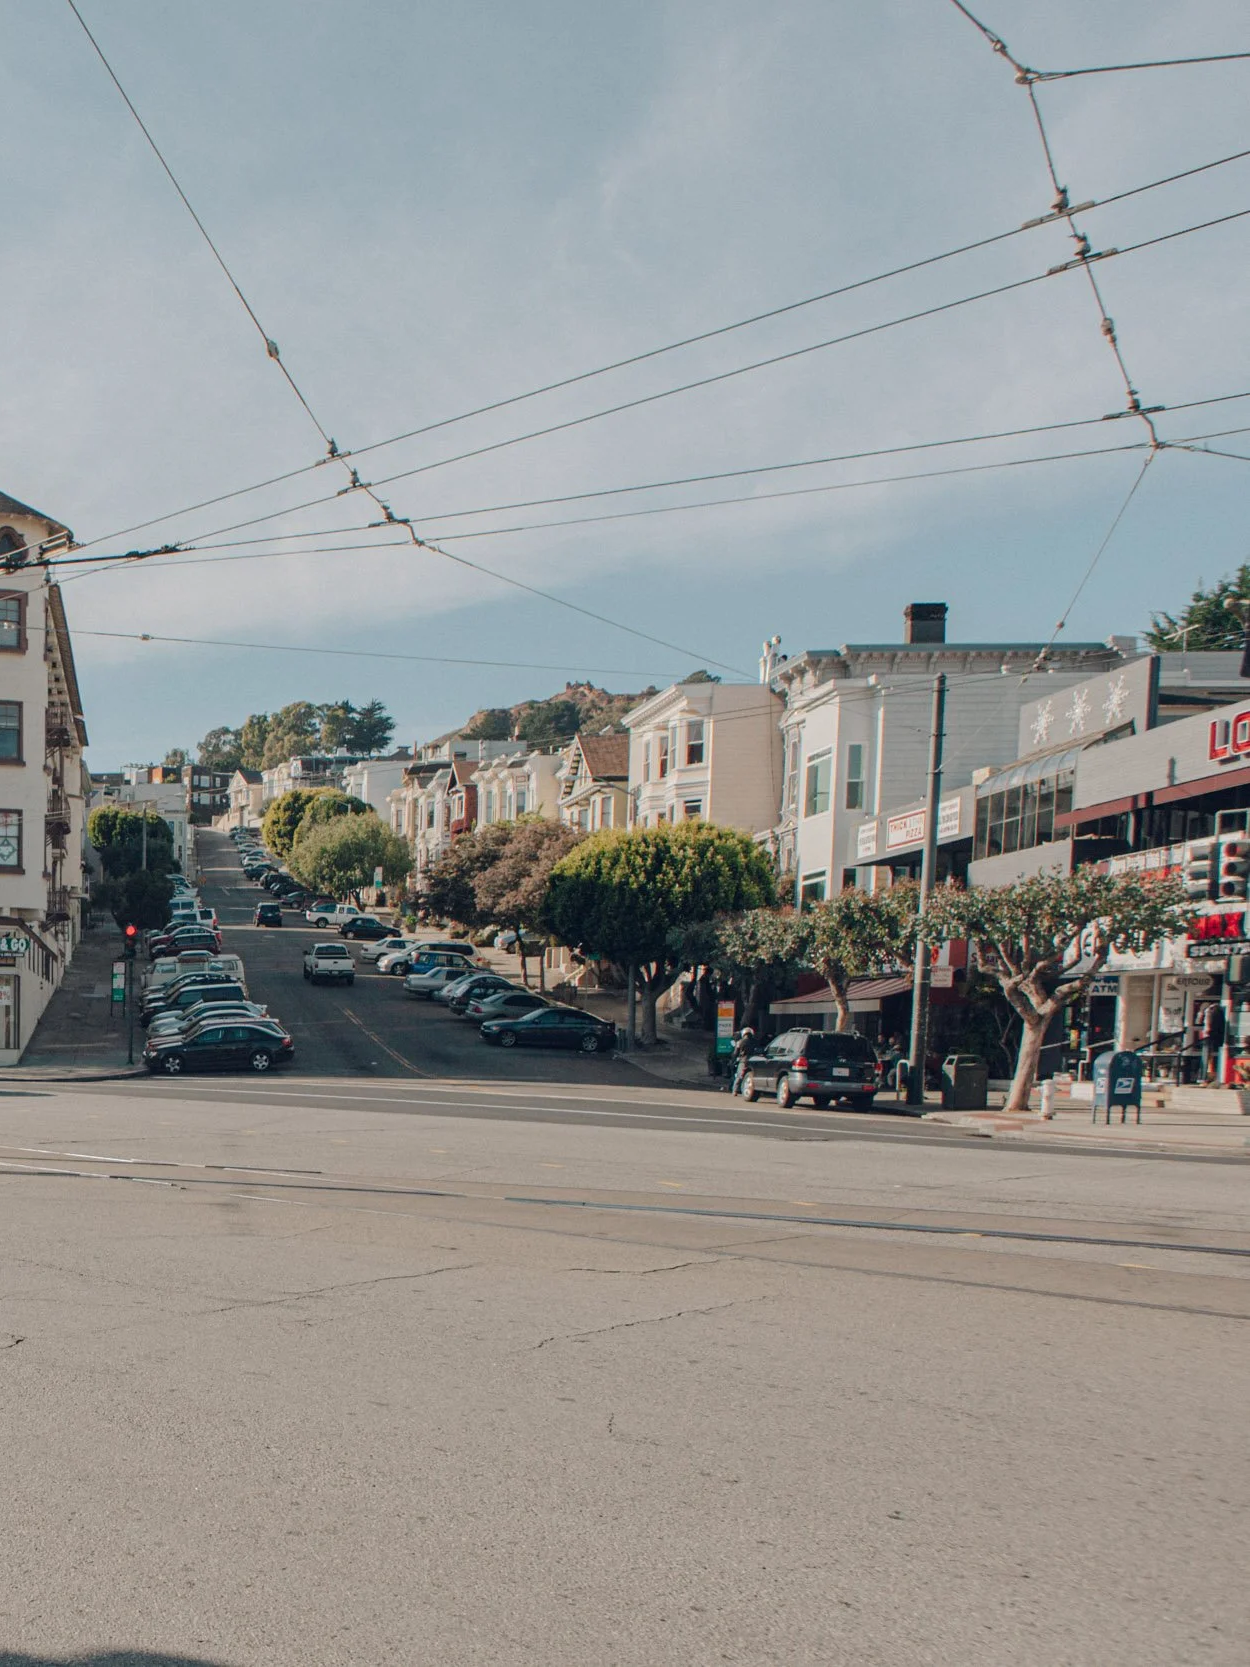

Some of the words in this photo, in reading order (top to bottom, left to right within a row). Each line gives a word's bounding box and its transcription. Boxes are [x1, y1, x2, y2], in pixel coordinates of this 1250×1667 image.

[905, 827, 922, 839] PIZZA
[0, 937, 8, 951] &
[11, 938, 27, 952] GO
[1092, 984, 1118, 993] ATM
